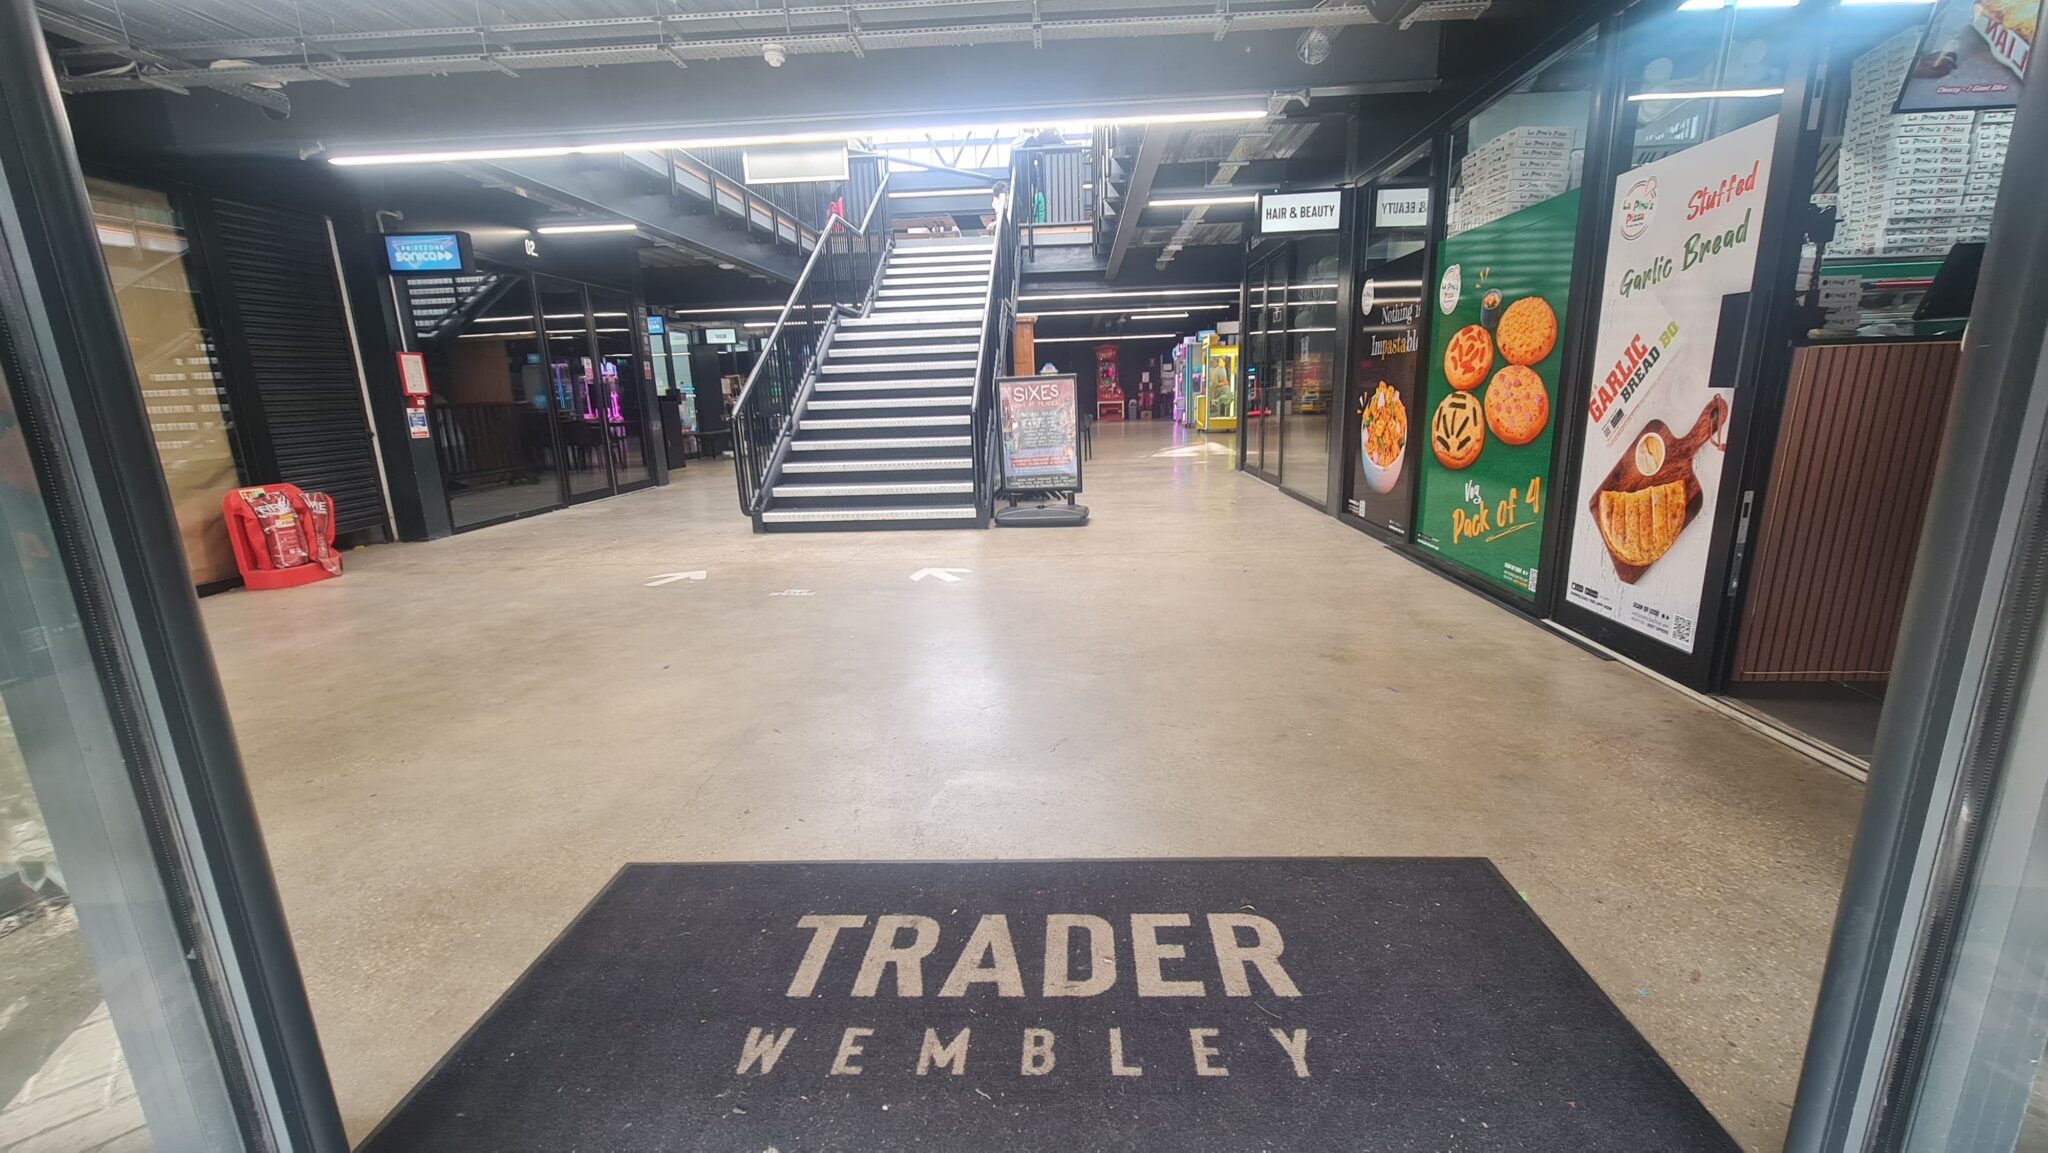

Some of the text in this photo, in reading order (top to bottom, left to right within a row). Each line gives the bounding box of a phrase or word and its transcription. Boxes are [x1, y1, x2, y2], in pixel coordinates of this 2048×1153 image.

[1266, 205, 1335, 220] HAIR & BEAUTY
[1687, 160, 1759, 220] Stuffed
[1626, 213, 1645, 224] Pizza
[1620, 208, 1751, 298] Garlic Bread
[1381, 303, 1413, 325] Nothing
[1013, 384, 1059, 402] SIXES
[1588, 334, 1648, 423] GARLIC
[1620, 346, 1660, 404] BREAD
[1453, 501, 1490, 544] Pack
[1525, 477, 1540, 513] 4
[1465, 480, 1481, 504] Veg
[785, 912, 1302, 998] TRADER
[736, 1027, 1311, 1078] WEMBLEY
